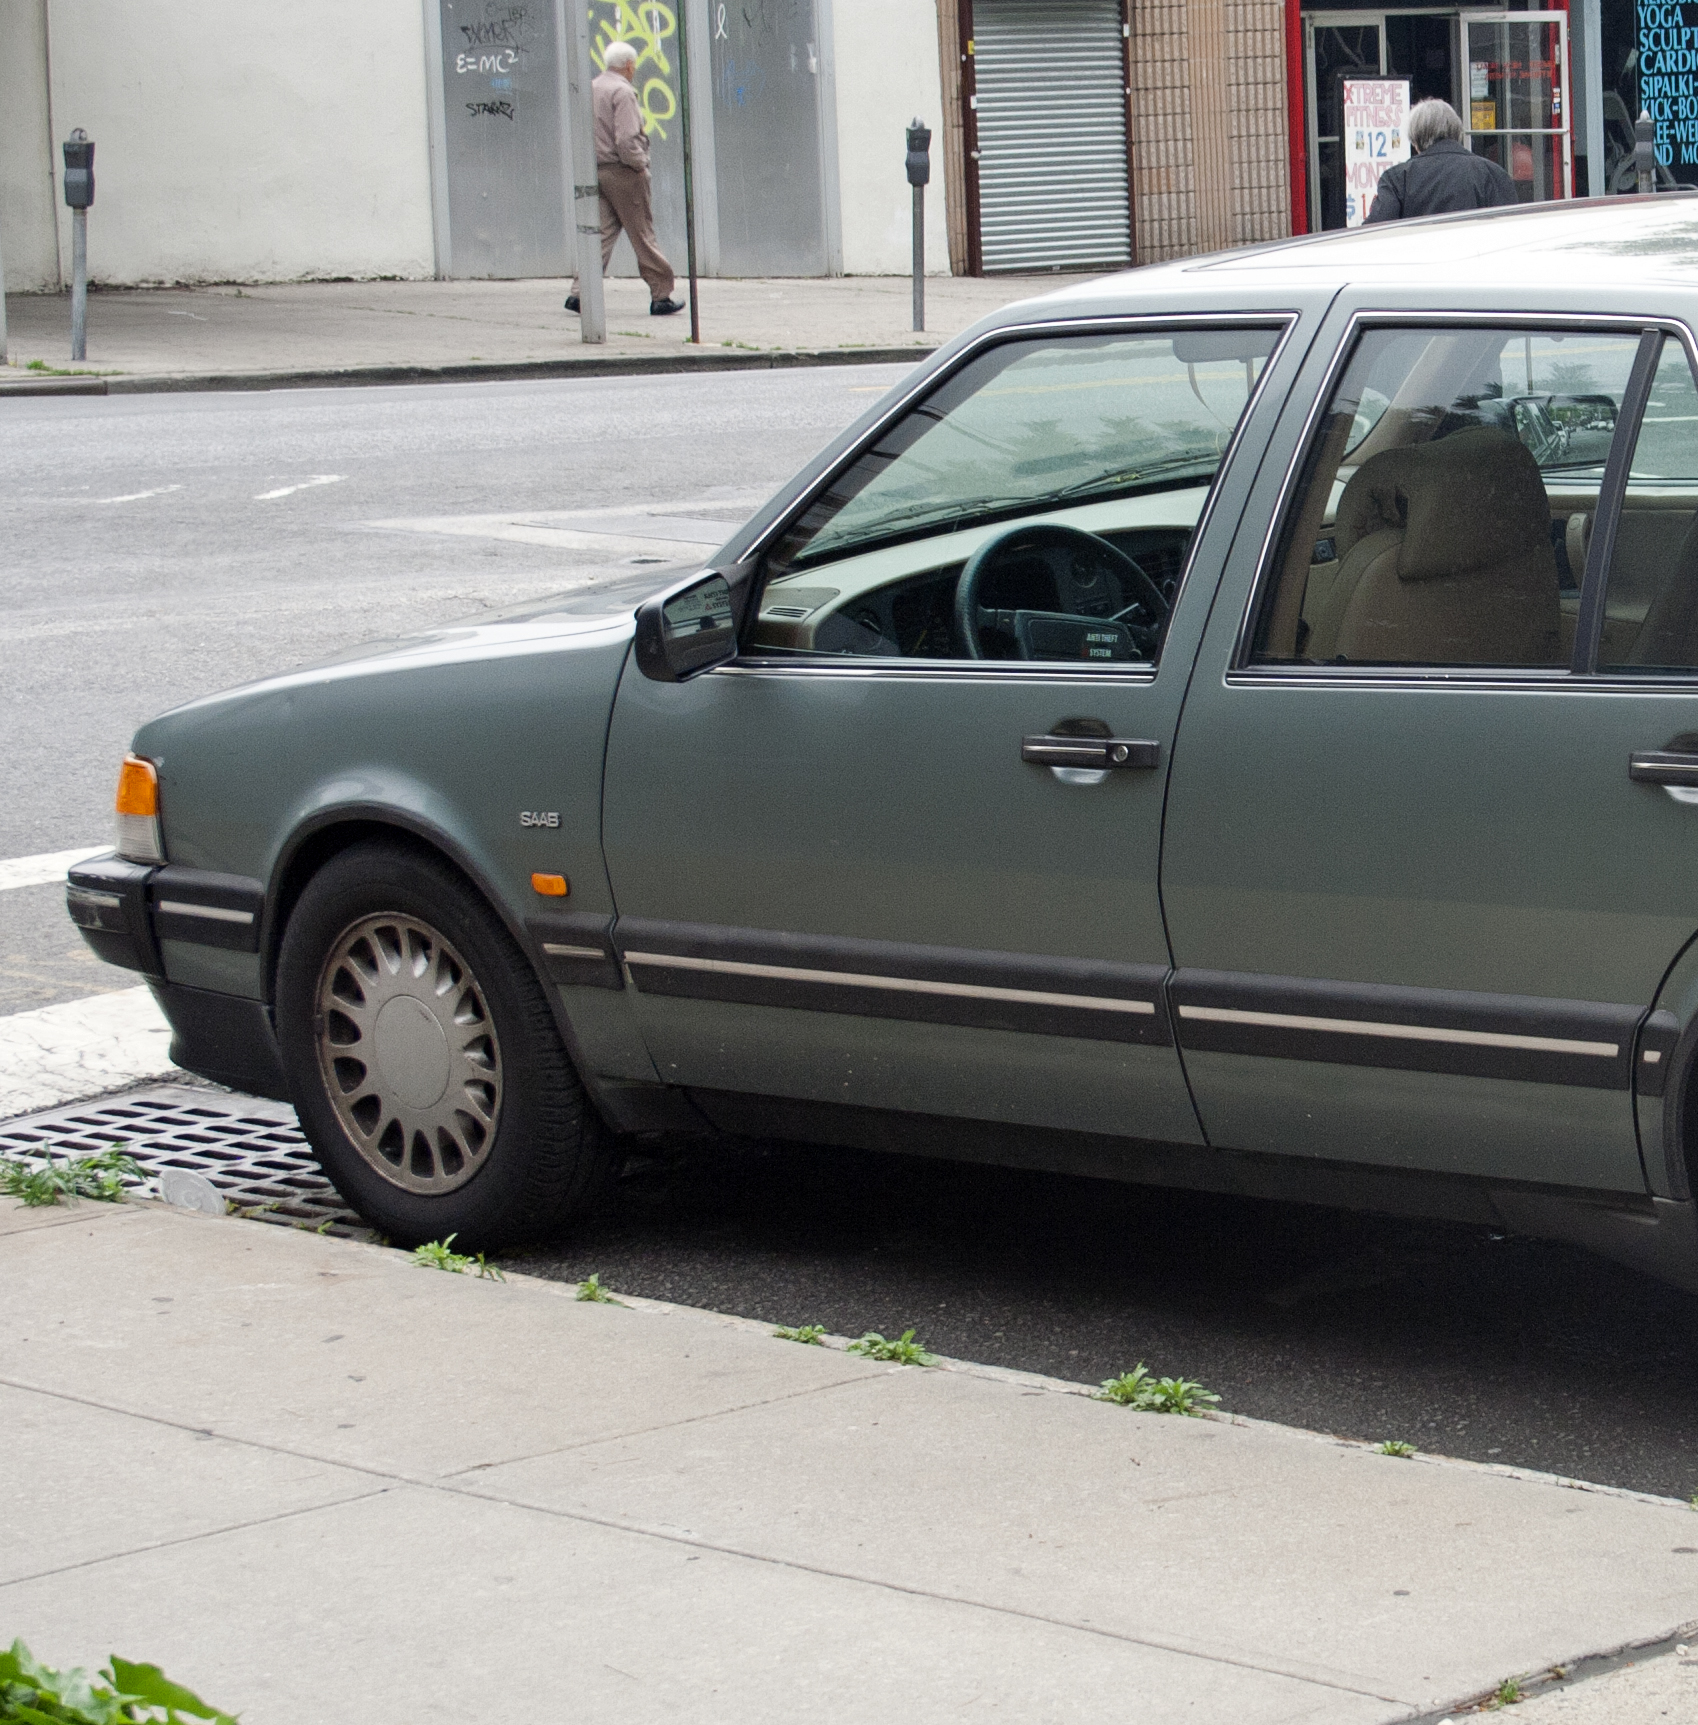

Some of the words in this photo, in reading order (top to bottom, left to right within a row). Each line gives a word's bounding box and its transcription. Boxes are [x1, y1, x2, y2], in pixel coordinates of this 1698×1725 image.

[1637, 5, 1683, 28] YOGA
[1344, 83, 1403, 105] XTREME
[1346, 105, 1404, 127] FITNESS
[1367, 131, 1387, 157] 12
[1654, 144, 1673, 166] ND
[1346, 161, 1394, 190] MONT
[519, 811, 560, 828] SAAB
